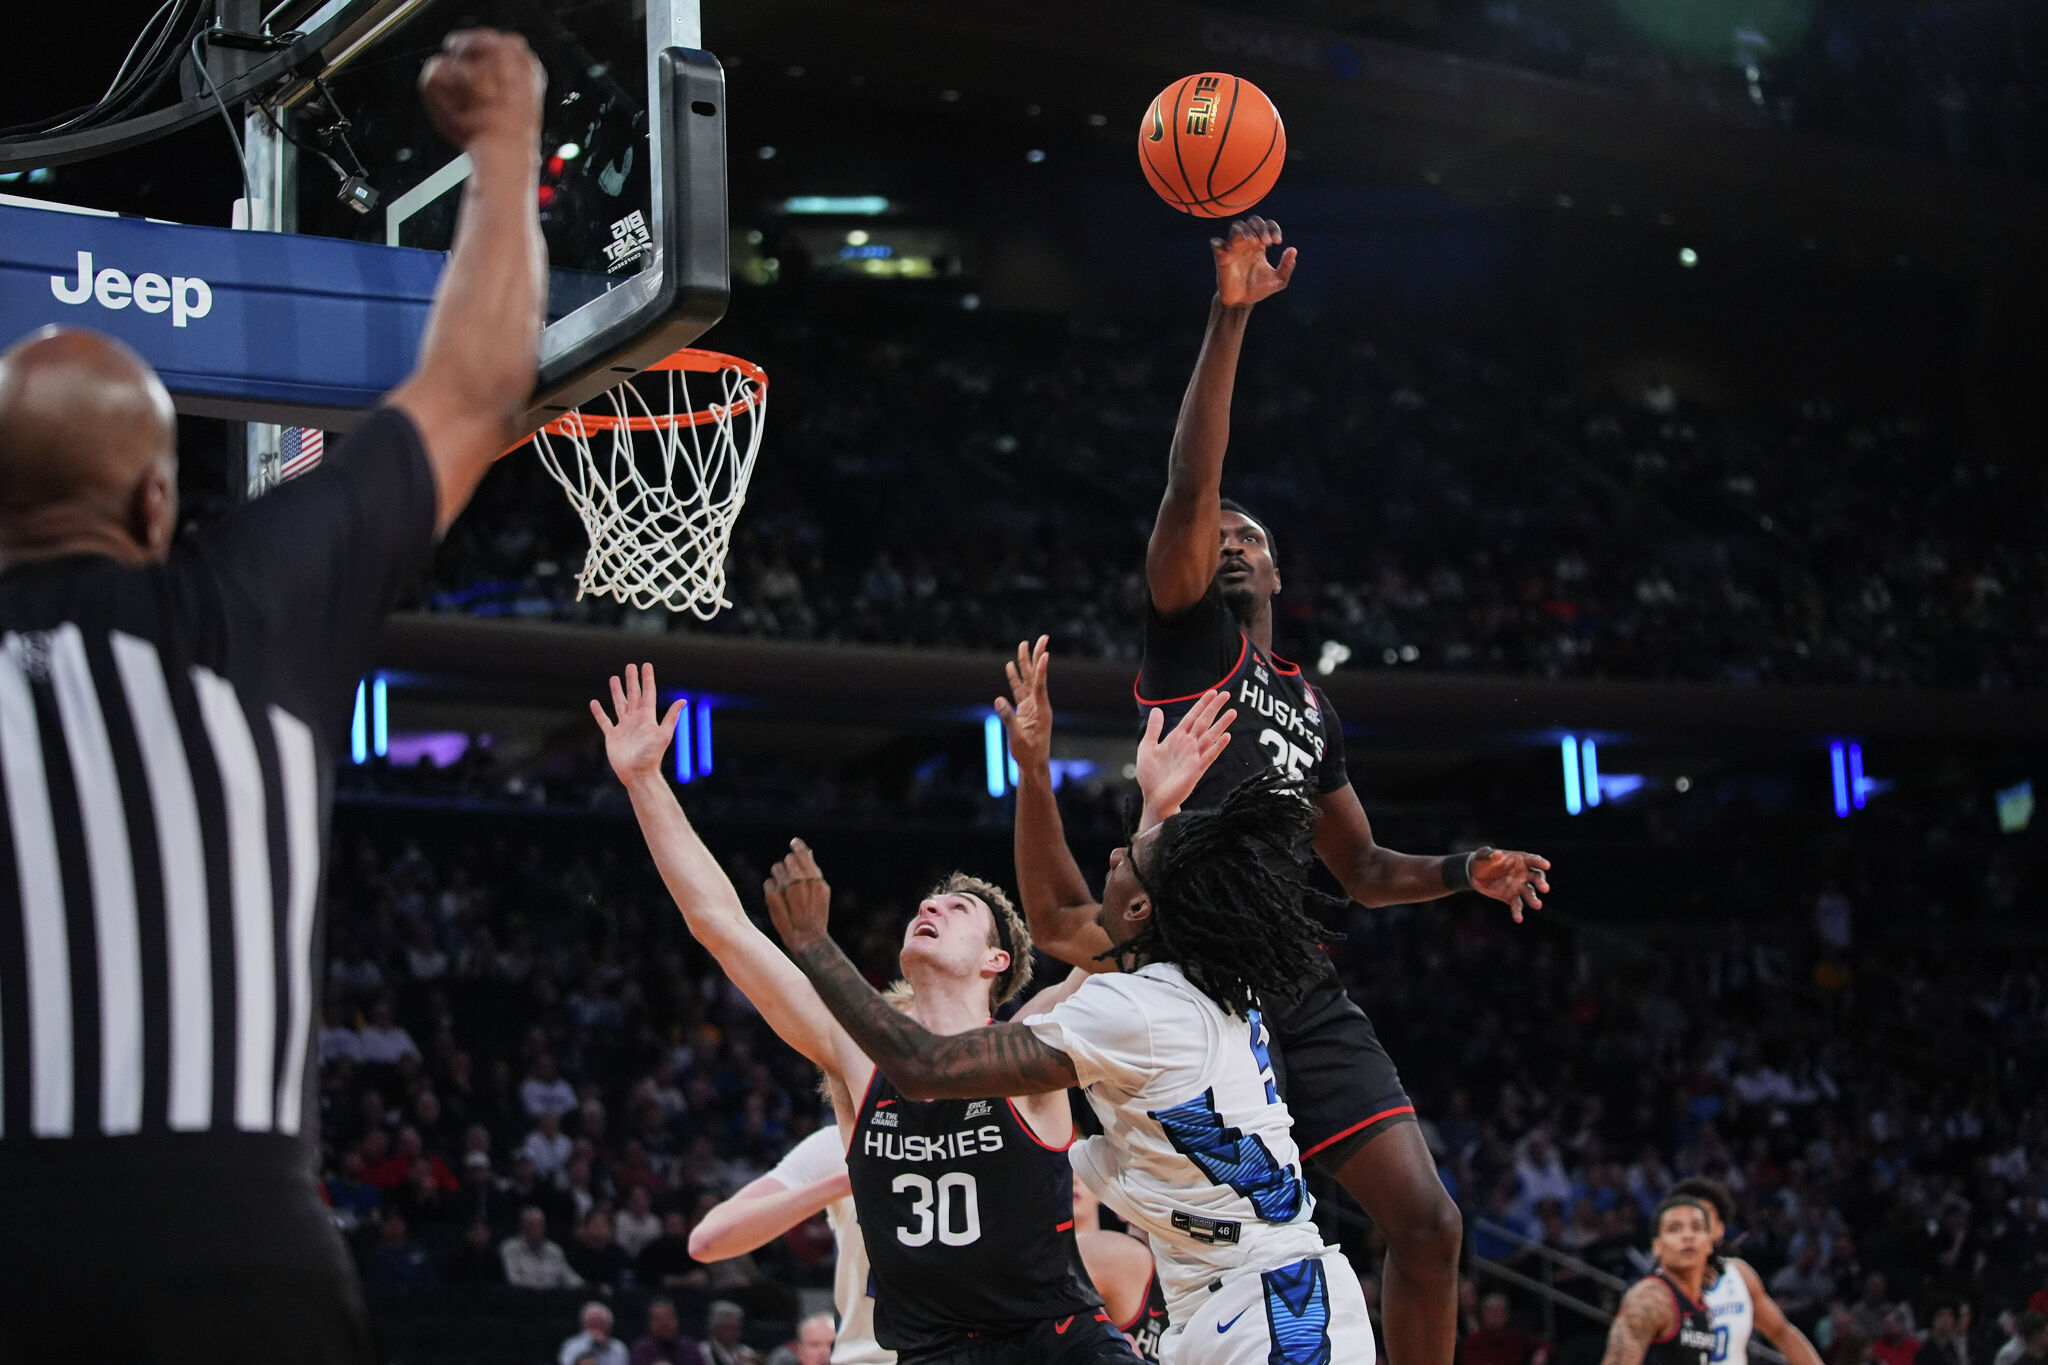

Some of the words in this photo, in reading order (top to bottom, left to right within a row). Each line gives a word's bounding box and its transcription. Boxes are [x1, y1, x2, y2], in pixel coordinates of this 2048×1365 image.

[1186, 76, 1219, 135] ELITE
[51, 251, 213, 327] Jeep
[968, 1101, 988, 1110] BIG
[874, 1111, 884, 1119] BE
[886, 1111, 899, 1121] THE
[966, 1106, 993, 1116] EAST
[871, 1118, 899, 1128] CHANGE
[864, 1125, 1004, 1162] HUSKIES
[892, 1172, 981, 1247] 30
[1218, 1226, 1230, 1236] 46
